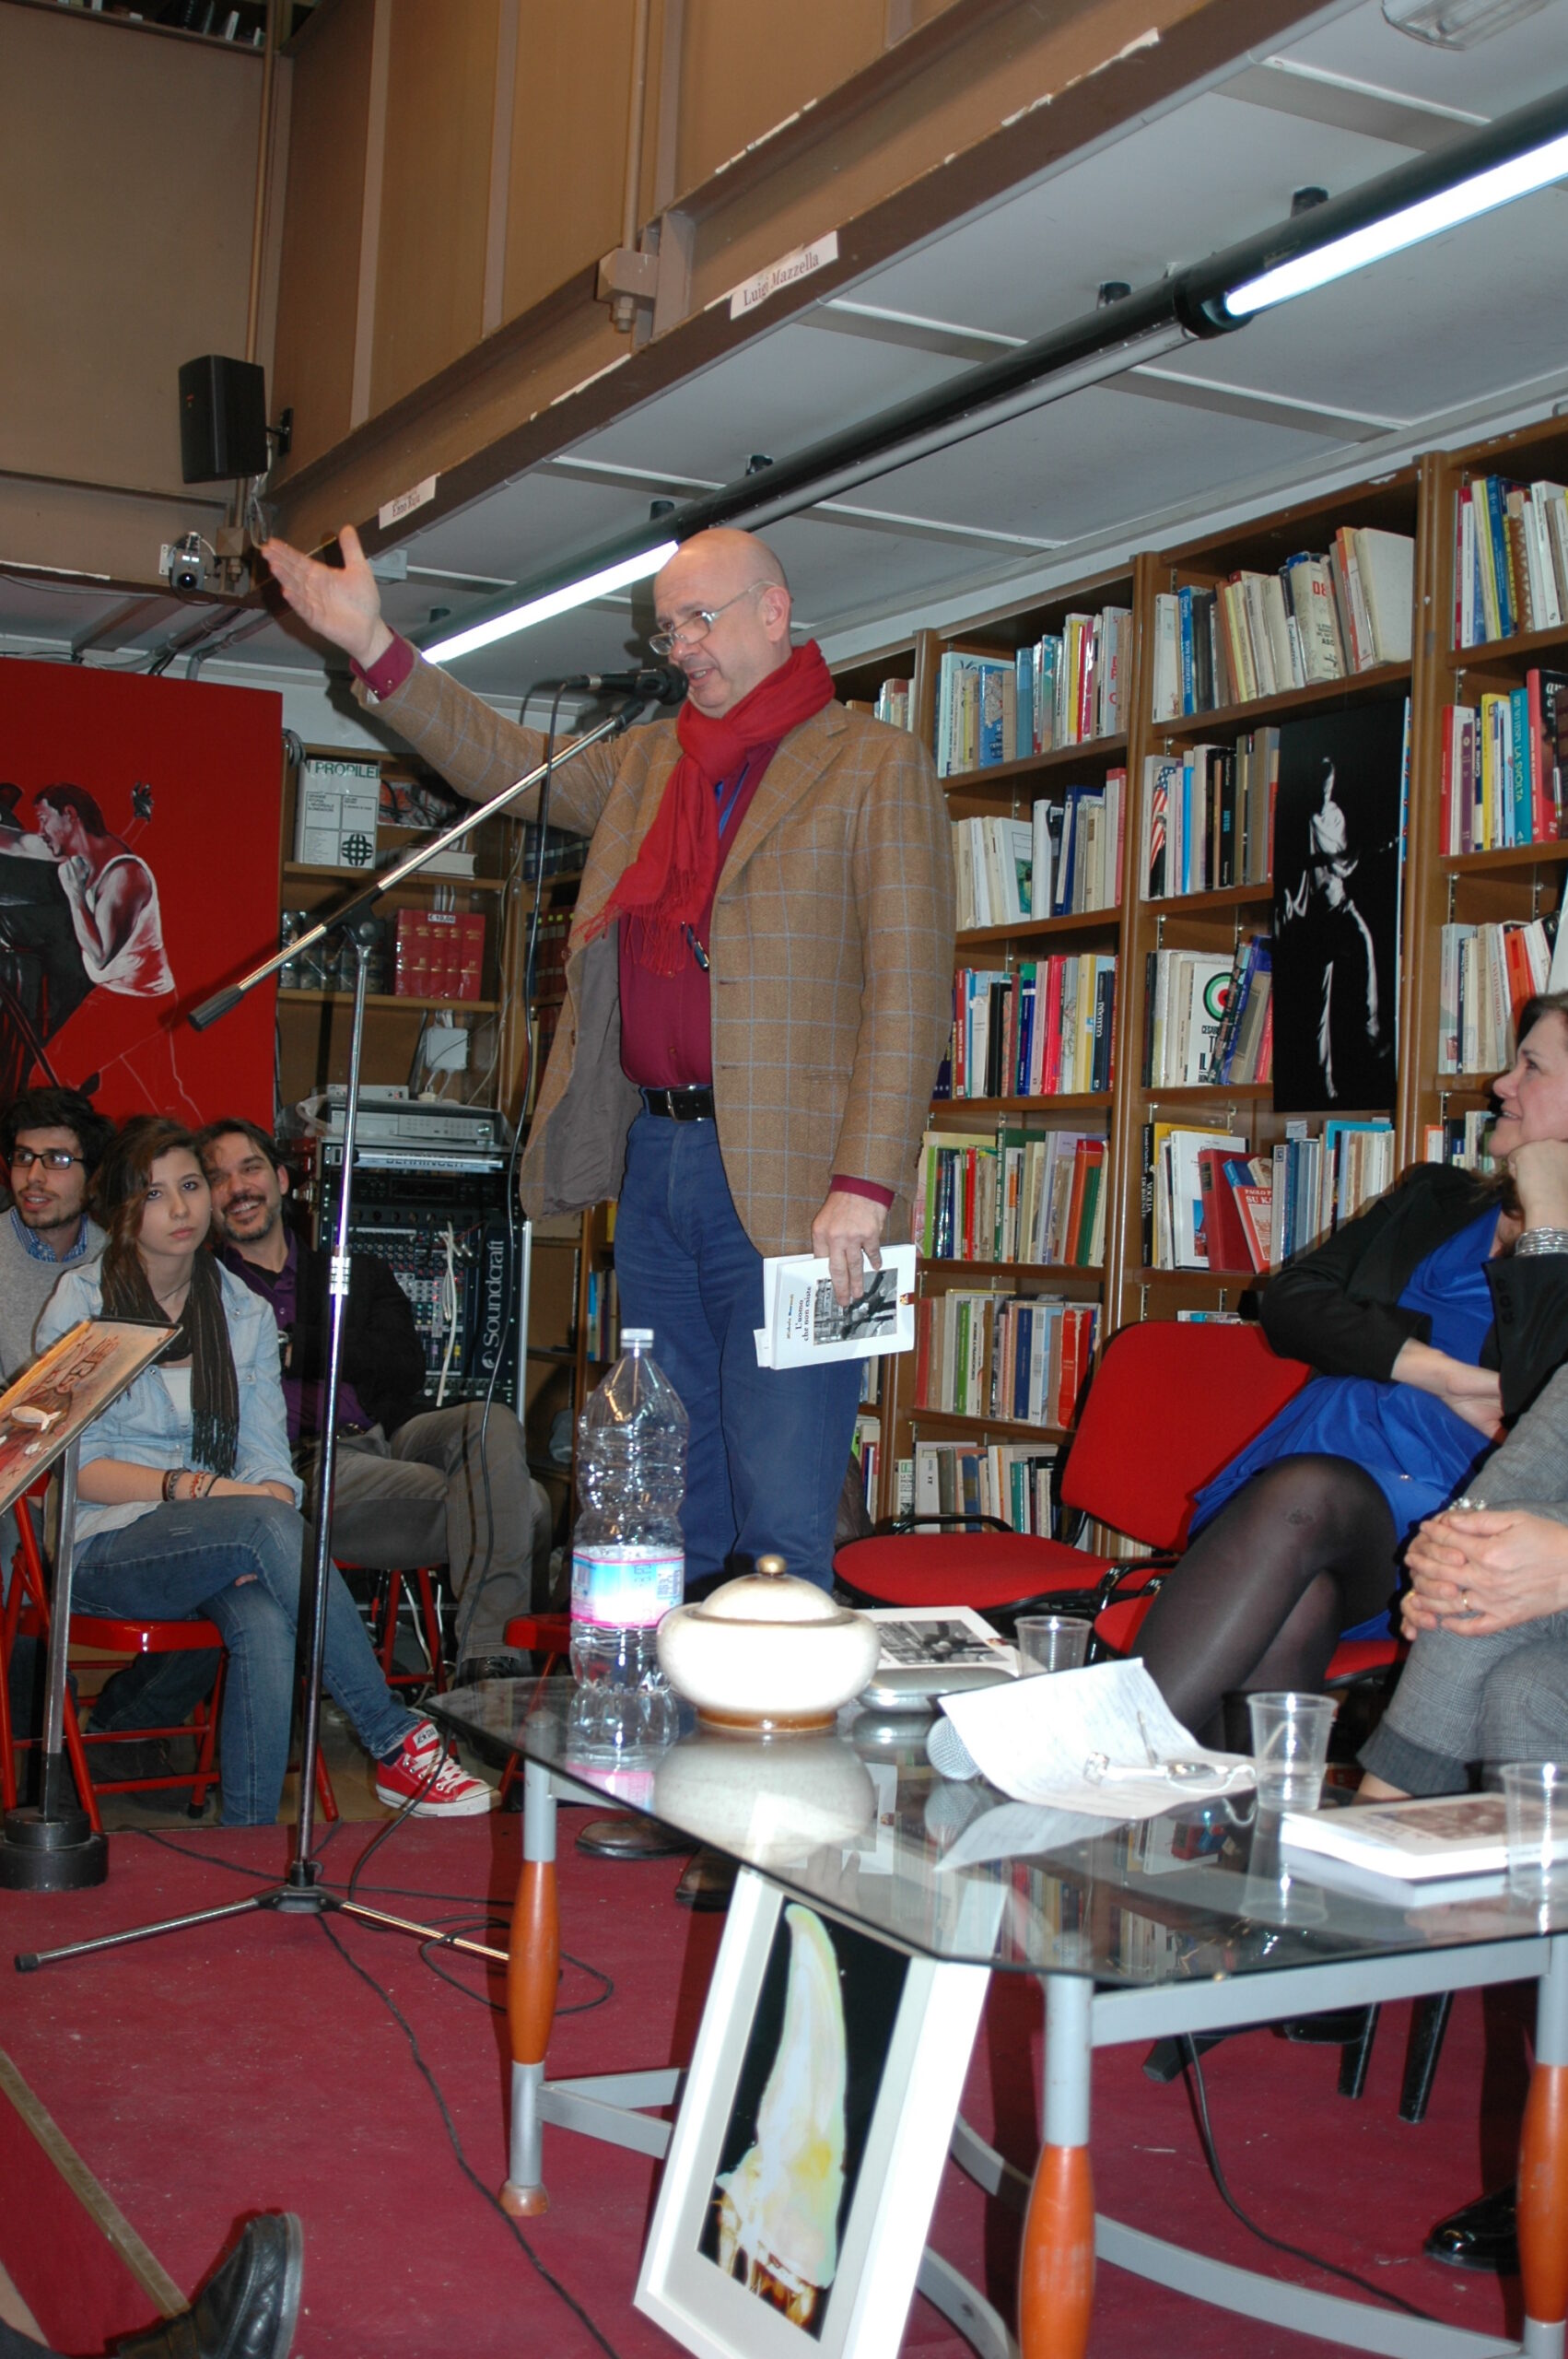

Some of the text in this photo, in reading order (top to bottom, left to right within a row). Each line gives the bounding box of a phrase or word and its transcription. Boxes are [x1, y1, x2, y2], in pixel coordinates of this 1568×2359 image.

[743, 252, 820, 307] Luigi Mazzella
[315, 761, 380, 780] PROPILEI
[1514, 761, 1524, 803] SVOLTA
[483, 1239, 505, 1347] Soundcraft
[795, 1299, 803, 1330] L'uomo
